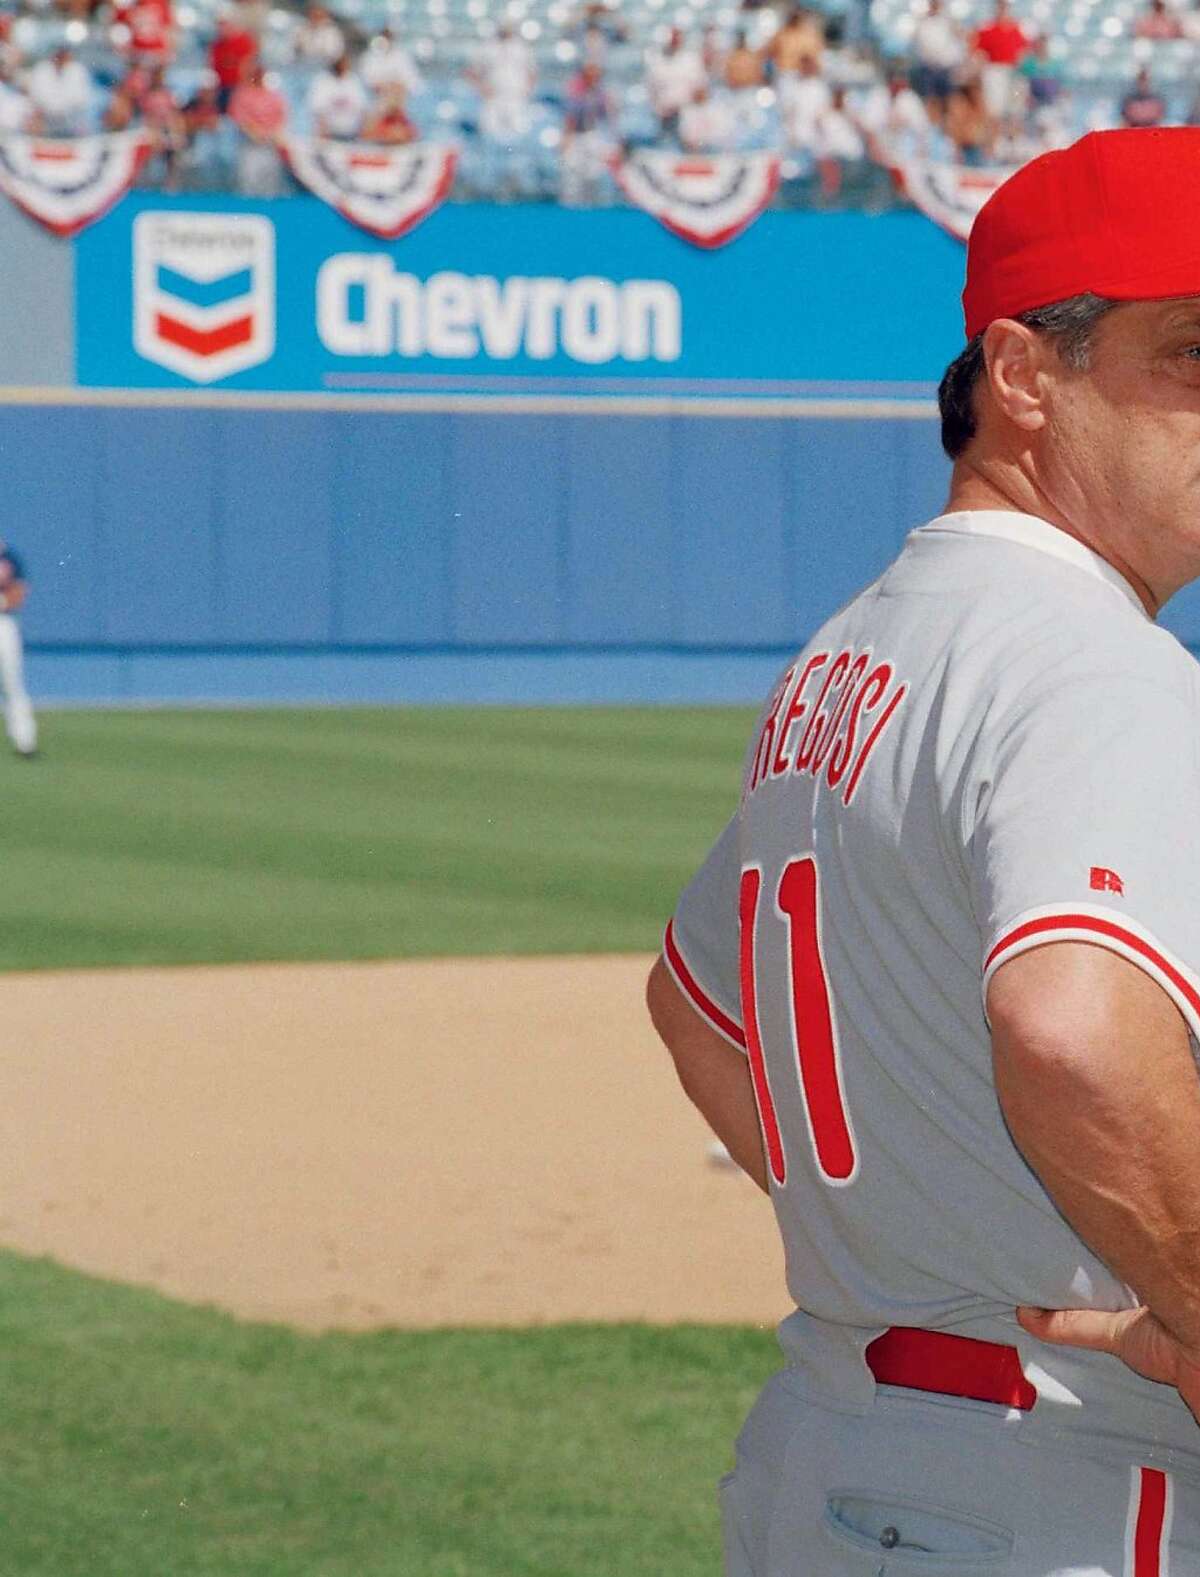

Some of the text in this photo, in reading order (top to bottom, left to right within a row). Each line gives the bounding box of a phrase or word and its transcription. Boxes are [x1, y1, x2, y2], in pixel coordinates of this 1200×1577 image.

[315, 251, 682, 364] Chevron
[744, 648, 910, 810] REGOSI
[738, 853, 857, 1185] 11
